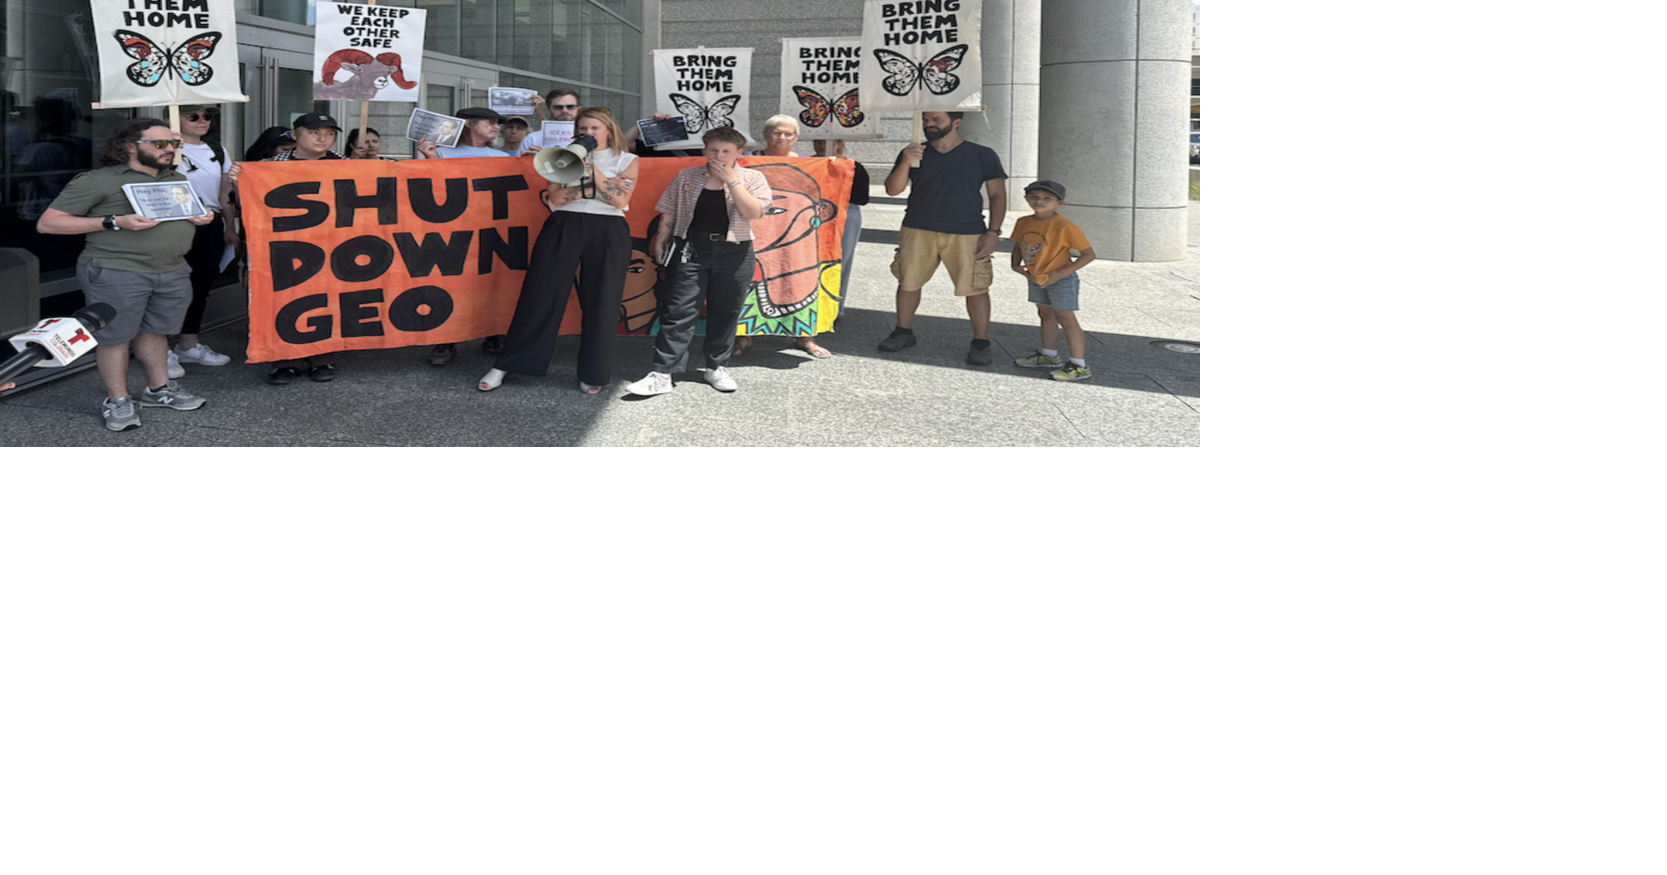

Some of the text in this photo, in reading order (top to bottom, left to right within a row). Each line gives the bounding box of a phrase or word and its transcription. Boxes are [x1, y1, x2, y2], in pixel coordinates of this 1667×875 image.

[127, 0, 209, 12] THEM
[337, 4, 410, 19] WE KEEP
[882, 0, 960, 18] BRING
[123, 11, 209, 29] HOME
[350, 16, 395, 28] EACH
[884, 14, 958, 32] THEM
[343, 26, 400, 39] OTHER
[884, 29, 958, 46] HOME
[349, 37, 393, 48] SAFE
[673, 55, 737, 67] BRING
[676, 68, 733, 80] THEM
[677, 80, 733, 93] HOME
[264, 174, 529, 233] SHUT
[268, 226, 529, 292] DOWN
[275, 285, 454, 345] GEO
